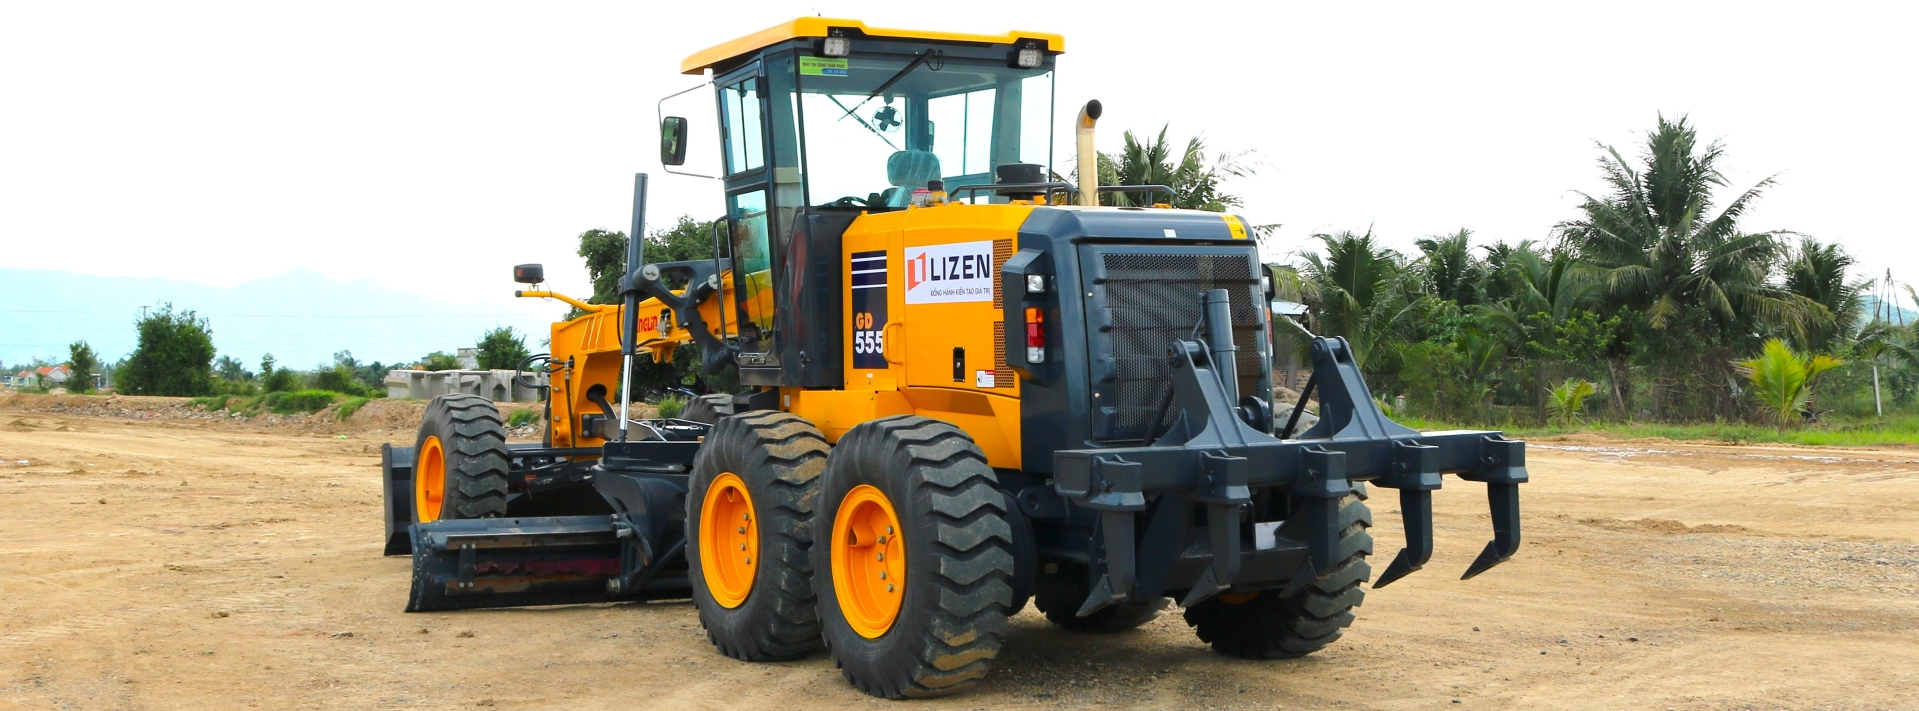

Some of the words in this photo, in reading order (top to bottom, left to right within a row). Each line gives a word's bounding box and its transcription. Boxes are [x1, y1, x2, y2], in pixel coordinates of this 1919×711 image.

[931, 253, 989, 281] LIZEN
[855, 312, 873, 330] GD
[855, 330, 884, 354] 555
